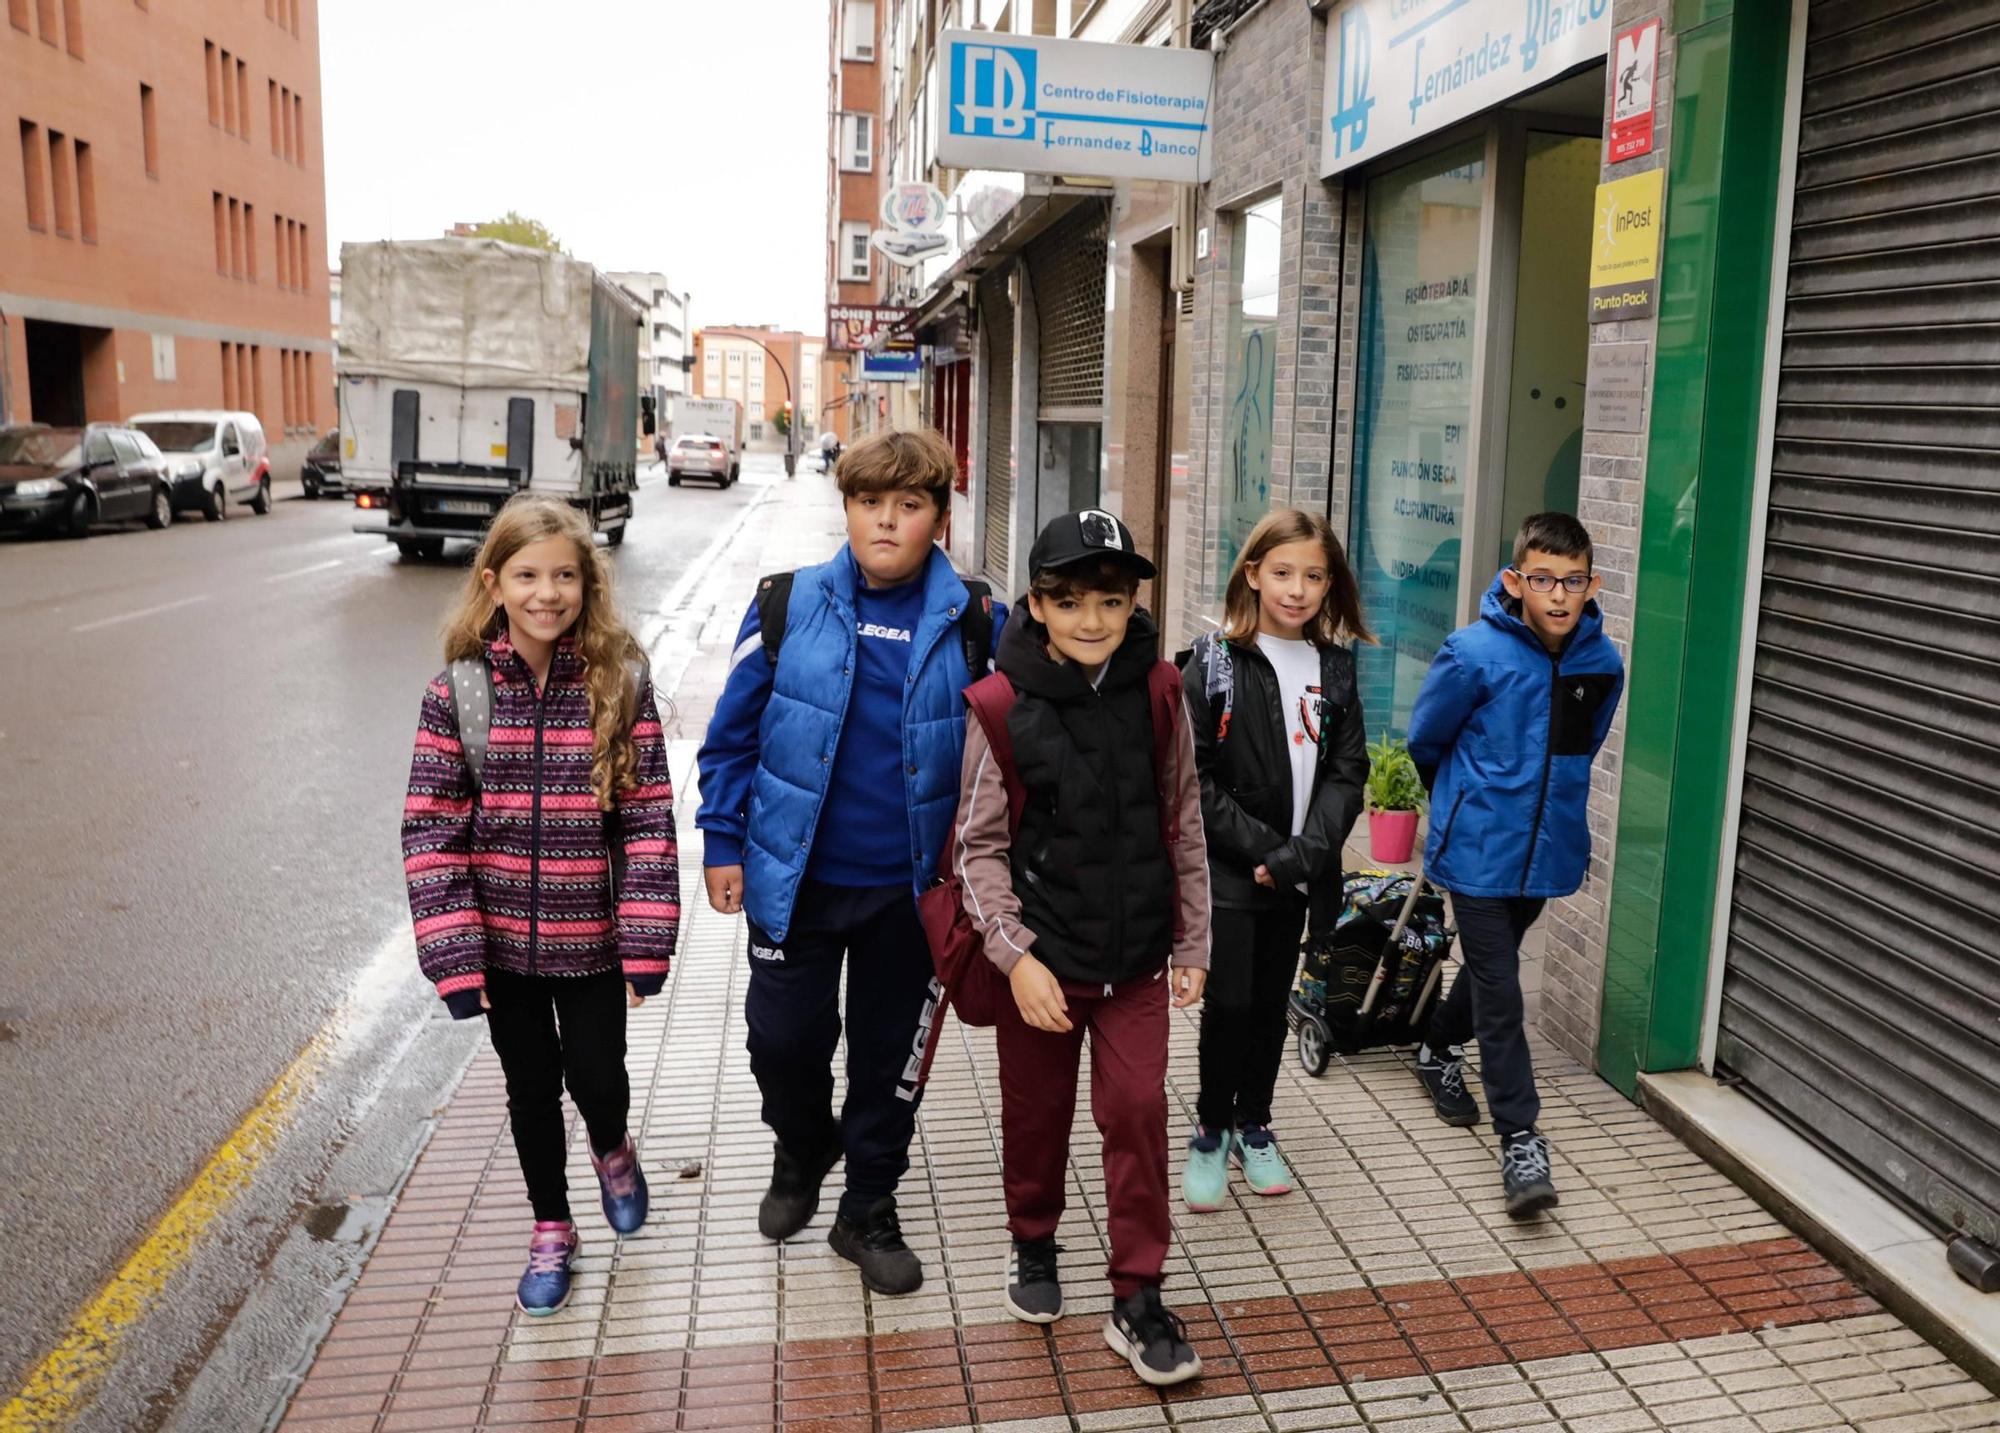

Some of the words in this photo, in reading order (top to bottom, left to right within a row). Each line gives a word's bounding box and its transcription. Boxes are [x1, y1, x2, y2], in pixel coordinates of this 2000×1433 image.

[1409, 31, 1511, 126] Fernández
[1043, 83, 1094, 101] Centro
[1096, 88, 1115, 102] de
[1117, 89, 1205, 111] Fisioterapia
[1043, 121, 1132, 149] Fernandez
[1138, 128, 1198, 157] Blanco
[1616, 206, 1652, 232] InPost
[1405, 278, 1470, 305] FISIOTERAPIA
[1593, 295, 1621, 311] Punto
[1622, 290, 1648, 307] Pack
[830, 307, 873, 320] DÖNER
[875, 309, 910, 321] KEBA
[1407, 316, 1467, 343] OSTEOPATÍA
[1396, 358, 1464, 382] FISIOESTÉTICA
[1444, 425, 1461, 443] EPI
[1391, 457, 1430, 482] PUNCIÓN
[1432, 464, 1457, 484] SECA
[1393, 499, 1455, 526] ACUPUNTURA
[1391, 559, 1421, 582] INDIBA
[895, 976, 941, 1102] LEGEA
